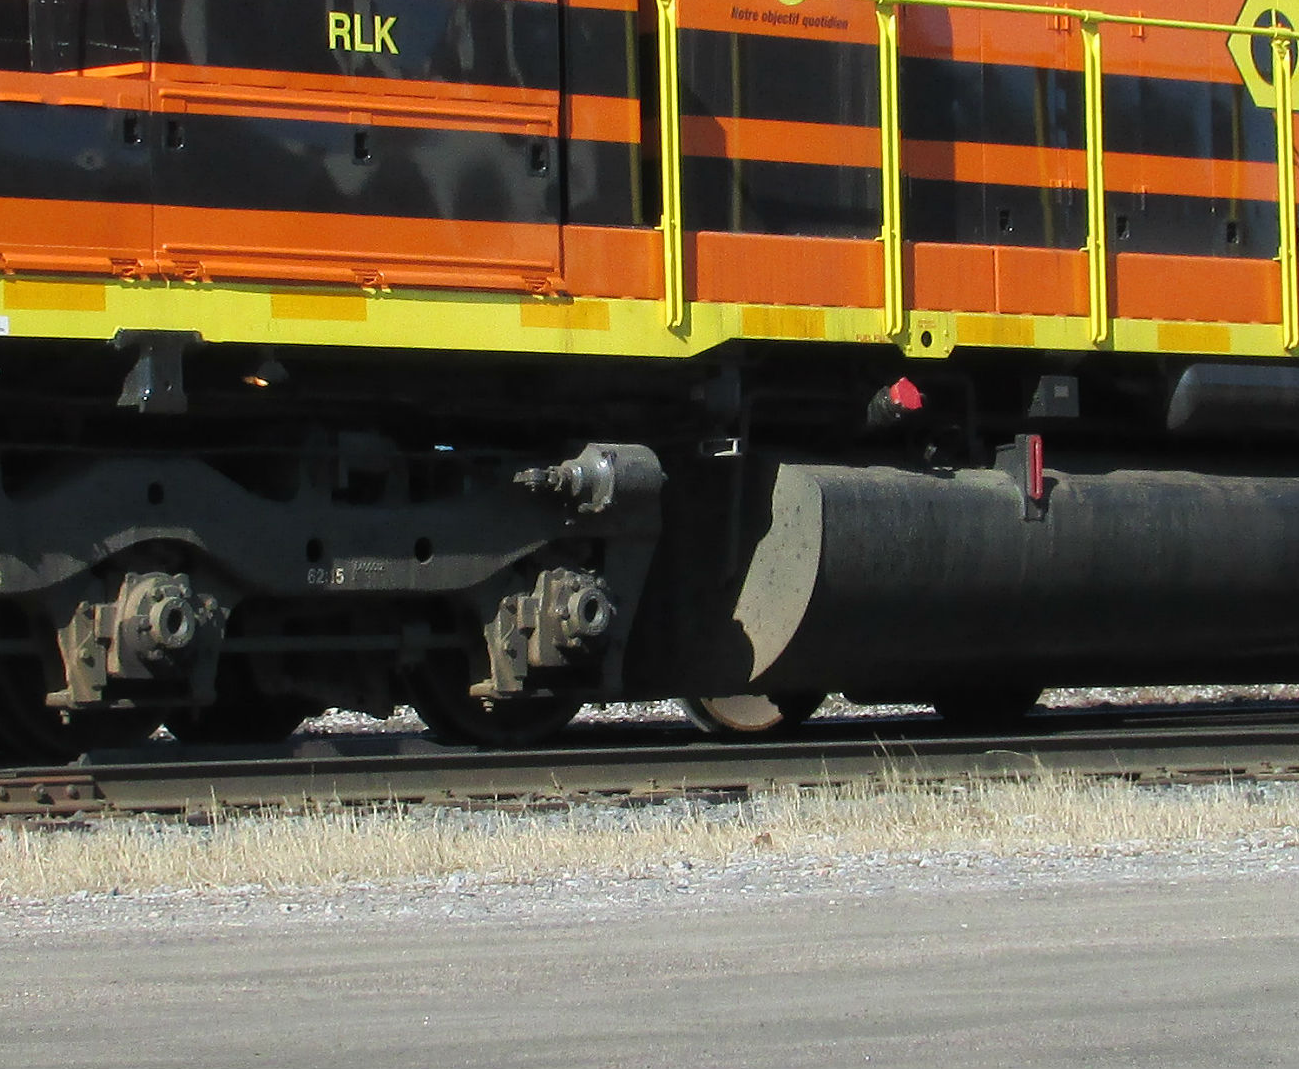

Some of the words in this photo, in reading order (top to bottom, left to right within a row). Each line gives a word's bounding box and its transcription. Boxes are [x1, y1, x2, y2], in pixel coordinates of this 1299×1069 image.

[328, 11, 400, 55] RLK
[731, 7, 759, 21] Notre
[762, 10, 799, 25] objectif
[802, 15, 849, 30] quotidien
